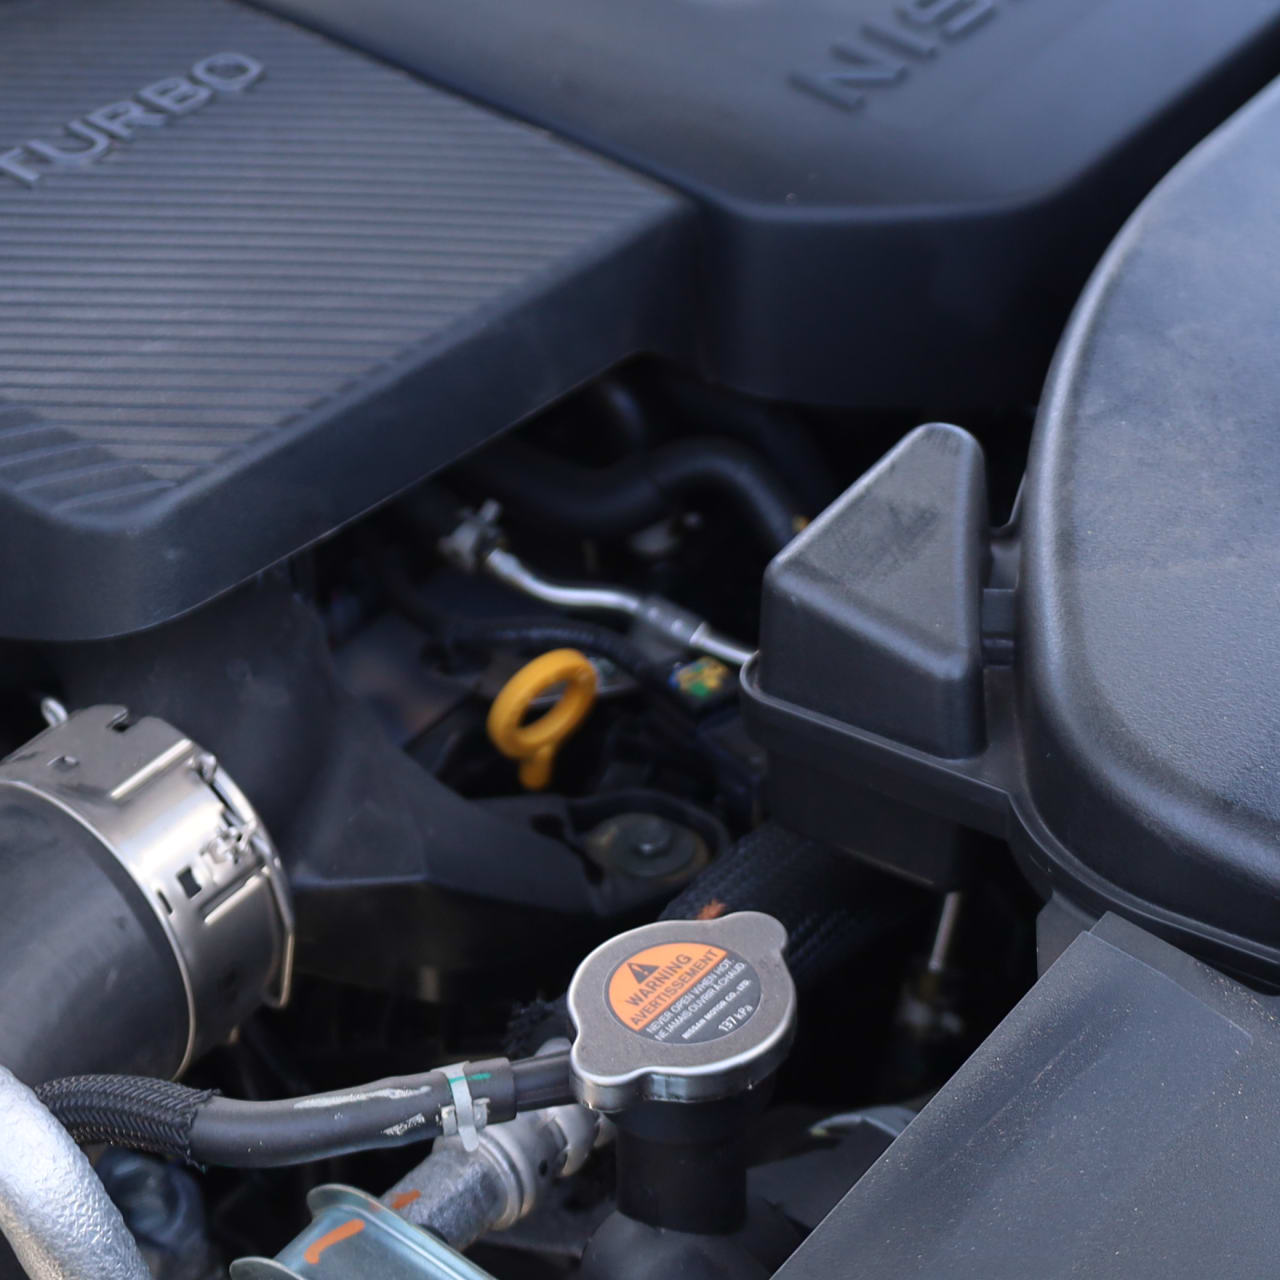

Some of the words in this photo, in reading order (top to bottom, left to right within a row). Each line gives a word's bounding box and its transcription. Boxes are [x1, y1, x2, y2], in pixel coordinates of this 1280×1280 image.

[625, 953, 692, 1007] WARNING
[629, 948, 718, 1026] AVERTISSEMENT
[646, 1010, 673, 1034] NEVER
[670, 991, 695, 1013] OPEN
[690, 972, 717, 995] WHEN
[654, 1028, 669, 1041] NE
[664, 1010, 693, 1033] JAMAIS
[687, 987, 717, 1013] OUVRIR
[718, 1015, 737, 1032] 137
[733, 1004, 753, 1020] kPa
